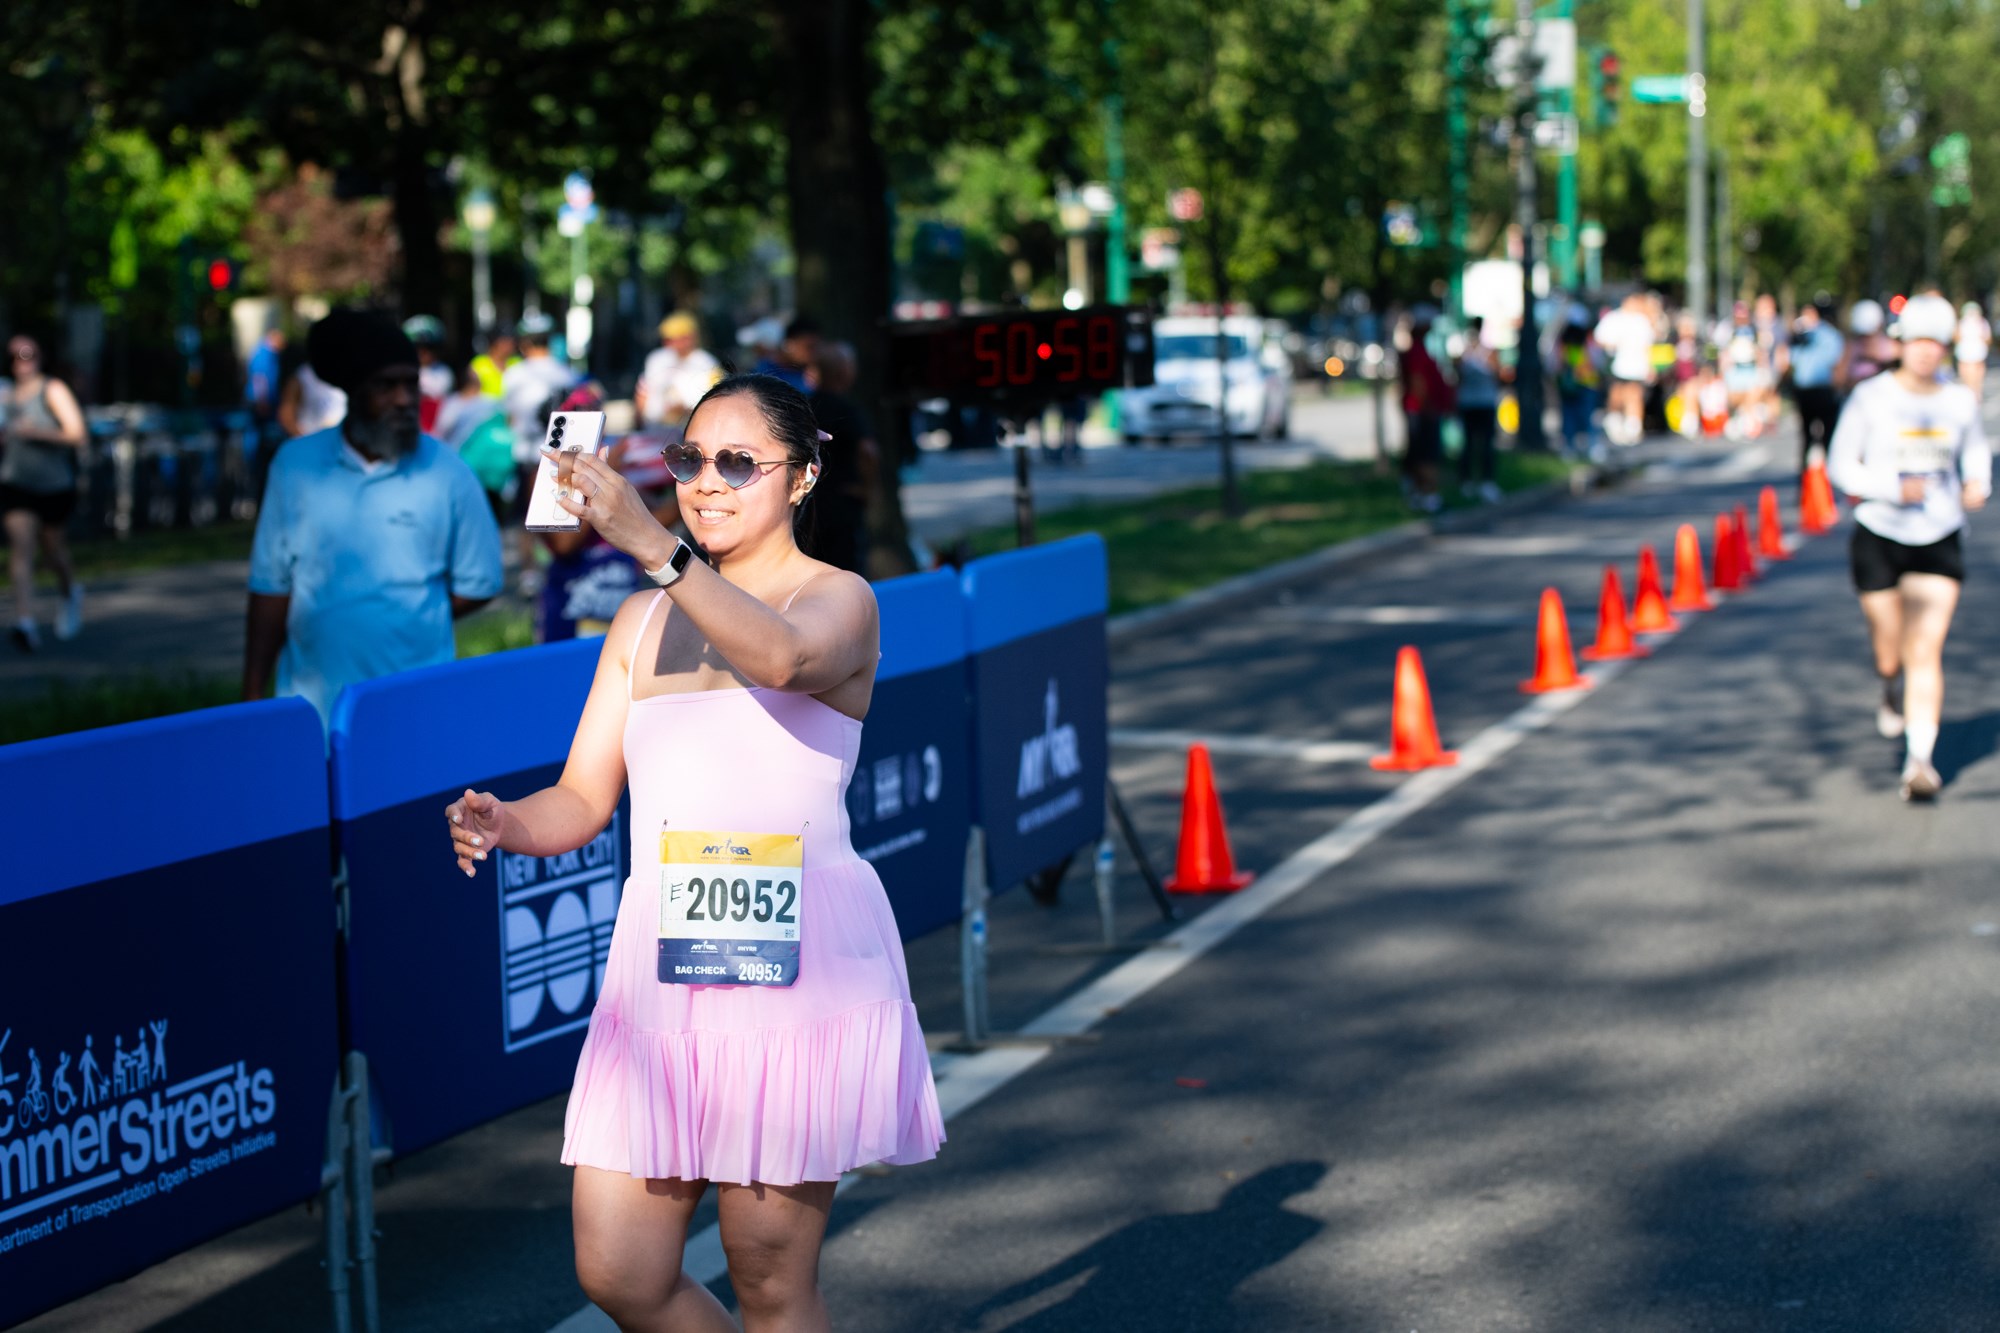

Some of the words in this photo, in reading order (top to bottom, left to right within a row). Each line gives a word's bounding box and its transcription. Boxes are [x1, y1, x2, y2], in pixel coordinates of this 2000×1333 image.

[686, 877, 797, 924] 20952
[675, 966, 693, 975] BAG
[694, 966, 727, 975] CHECK
[738, 963, 782, 982] 20952
[0, 1217, 53, 1254] artment
[54, 1208, 69, 1231] of
[70, 1180, 157, 1225] Transportation
[157, 1167, 189, 1192] Open
[189, 1149, 231, 1178] Streets
